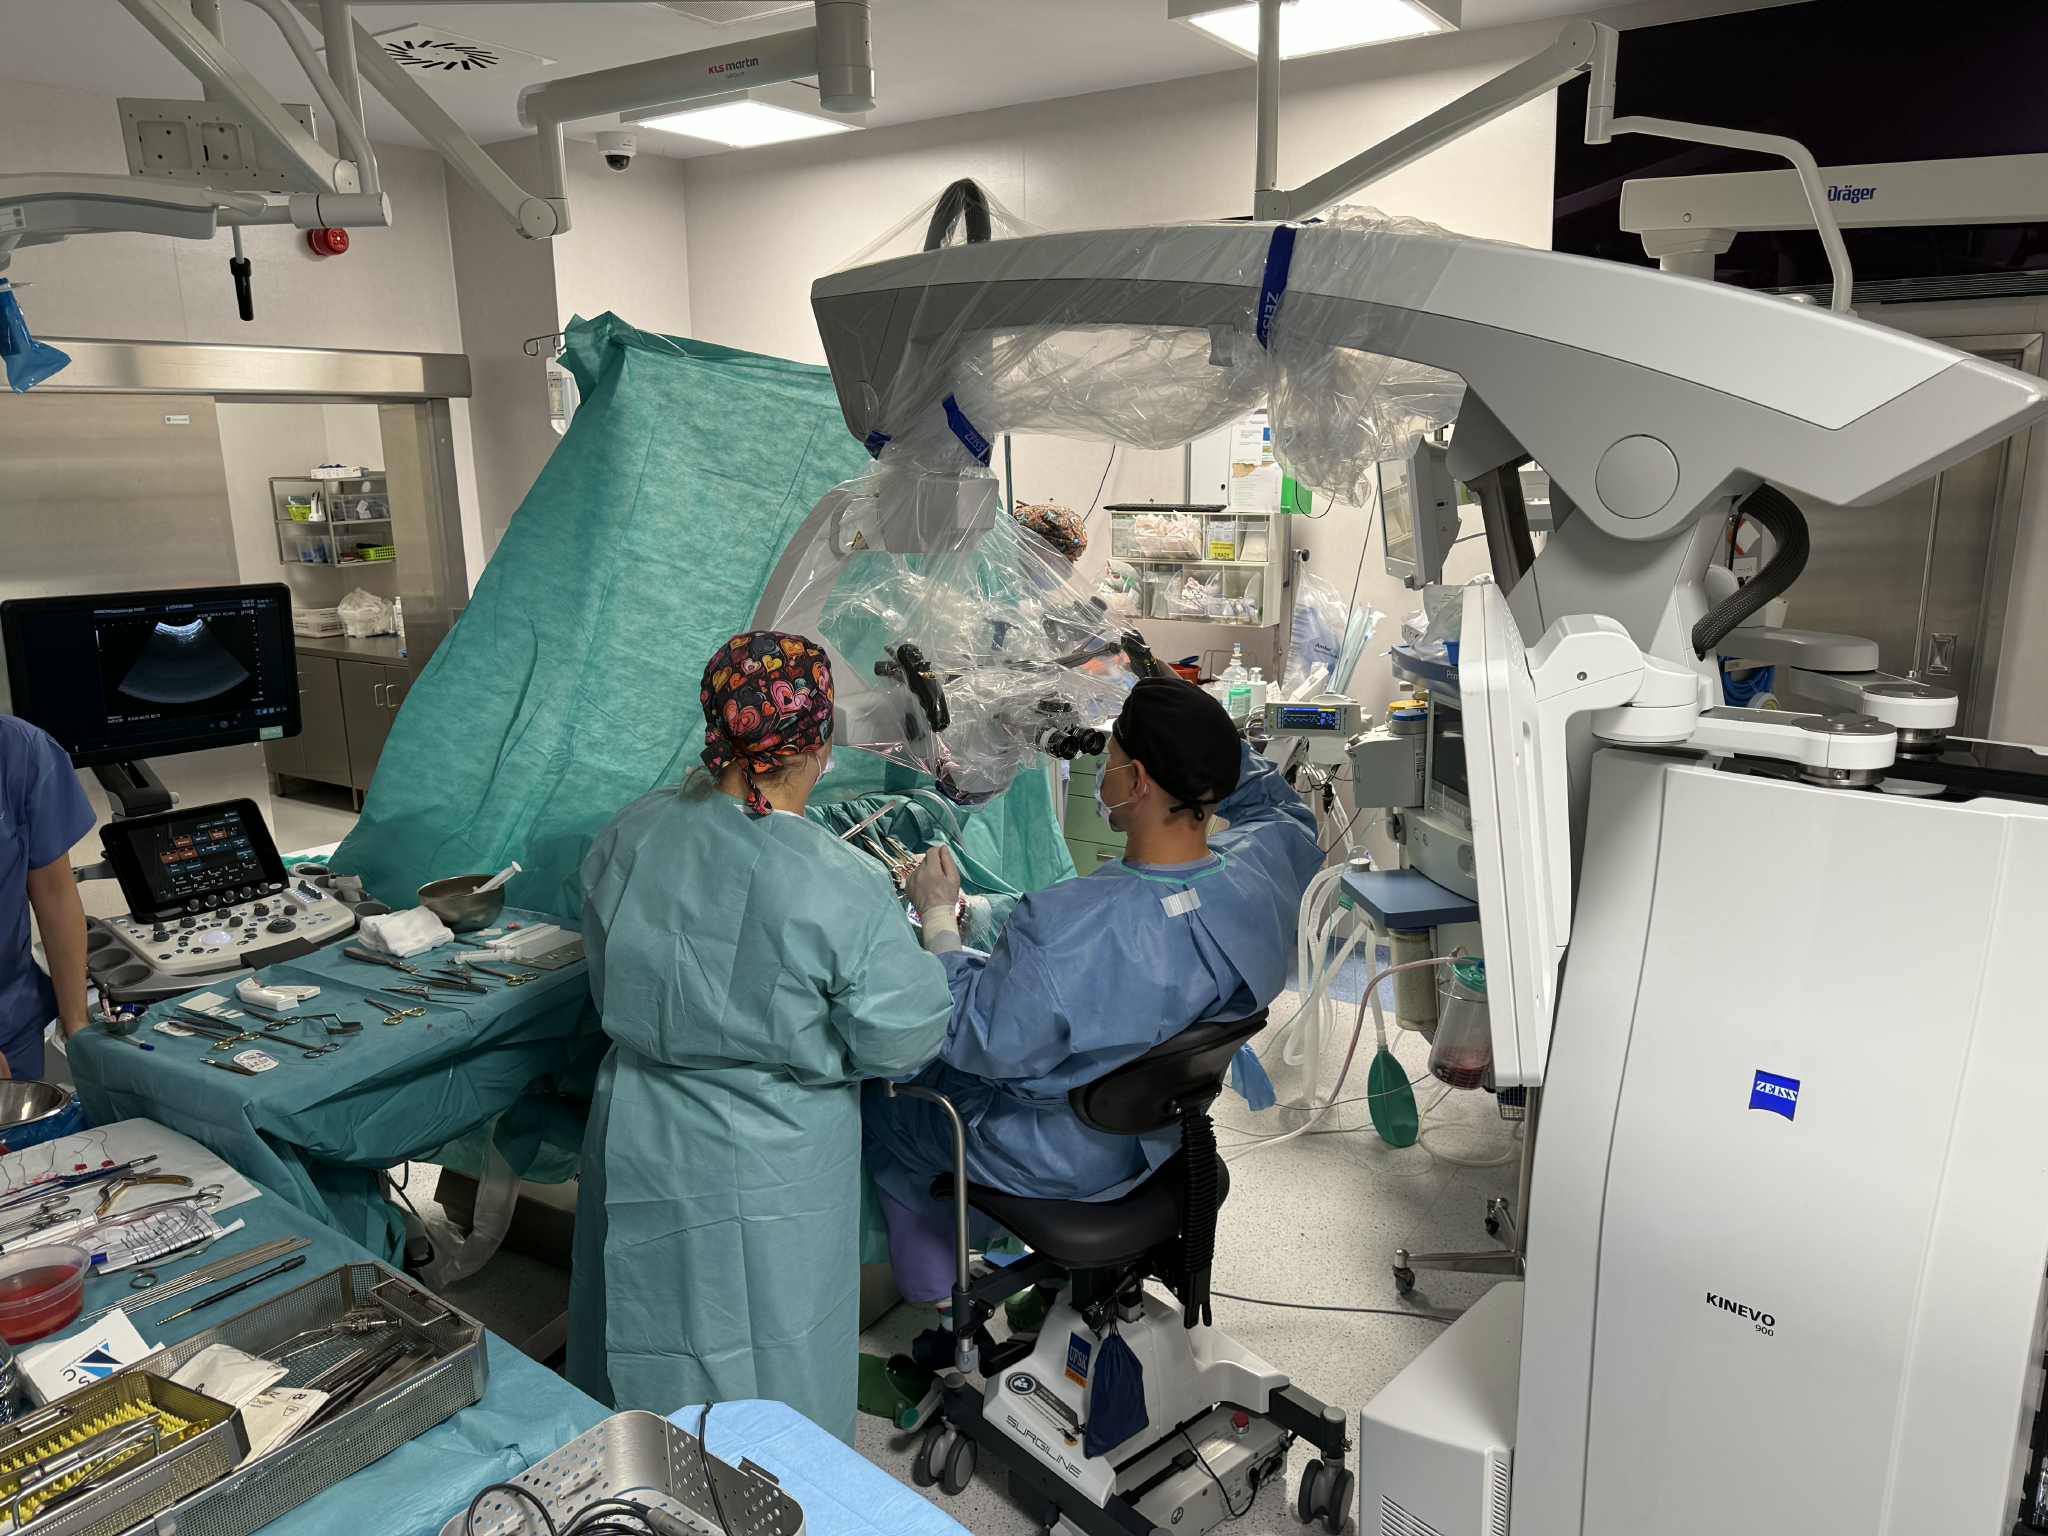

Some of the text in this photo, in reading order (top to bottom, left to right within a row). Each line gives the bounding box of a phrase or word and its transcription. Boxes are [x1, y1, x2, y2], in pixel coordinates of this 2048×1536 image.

[708, 64, 725, 75] KLS
[725, 57, 760, 71] martin
[1827, 184, 1877, 204] Dräger
[1755, 1080, 1798, 1102] ZEISS
[1706, 1292, 1776, 1327] KINEVO
[1755, 1324, 1775, 1337] 900
[1006, 1414, 1083, 1479] SURGILINE
